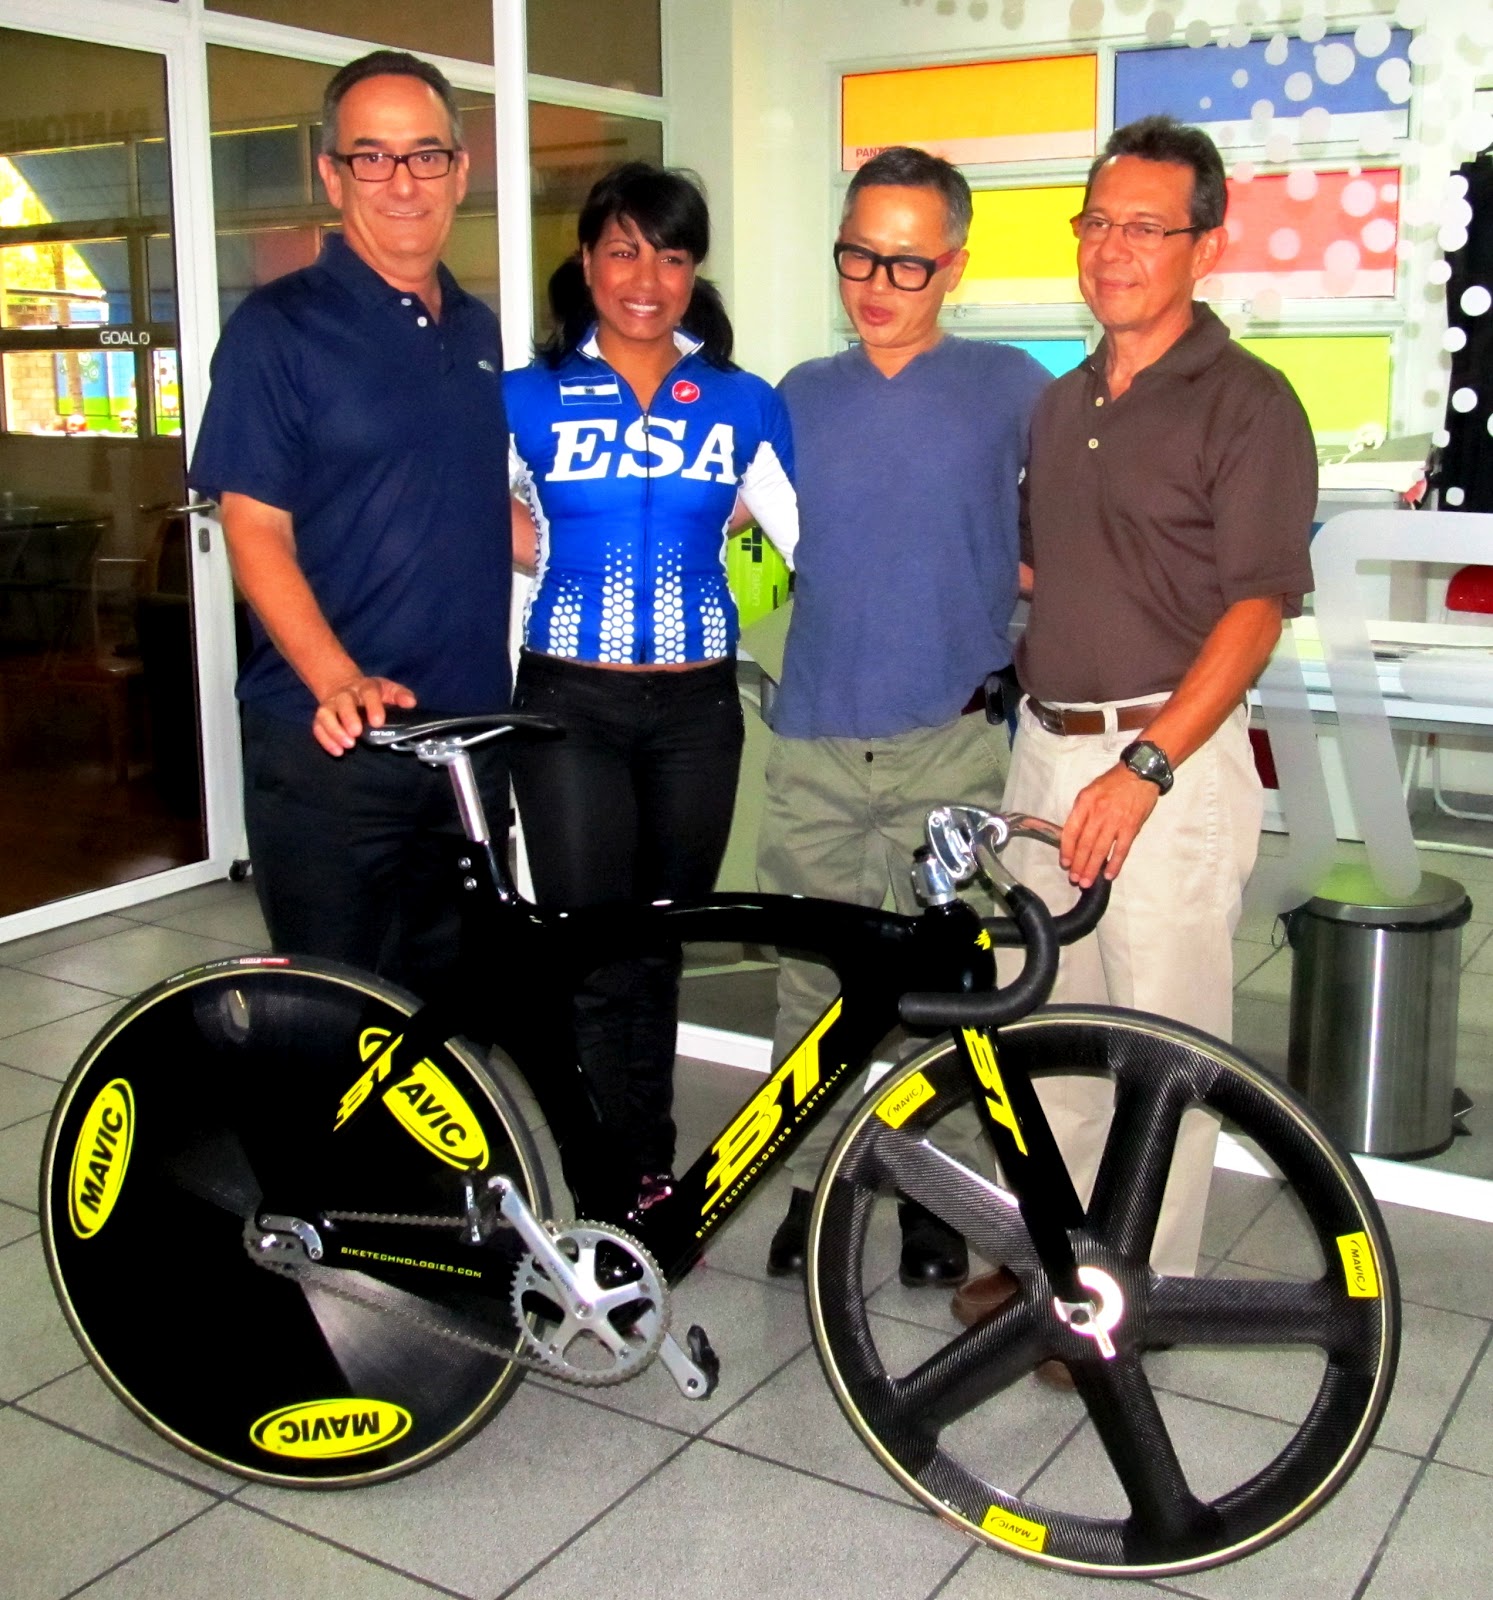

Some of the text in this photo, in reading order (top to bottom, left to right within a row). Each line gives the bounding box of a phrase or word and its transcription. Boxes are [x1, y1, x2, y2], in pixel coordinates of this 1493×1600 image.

[855, 147, 884, 158] PANT
[545, 415, 738, 485] ESA
[396, 1082, 467, 1148] AVIC
[893, 1089, 918, 1113] MAVIC
[80, 1107, 123, 1214] MAVIC
[695, 1063, 848, 1238] BIKE TECHNOLOGIES AUSTRALIA
[340, 1246, 482, 1278] BIKETECHNOLOGIES.COM
[1351, 1248, 1366, 1283] MAVIC
[278, 1411, 380, 1444] MAVIC
[998, 1520, 1031, 1538] MAVIC
